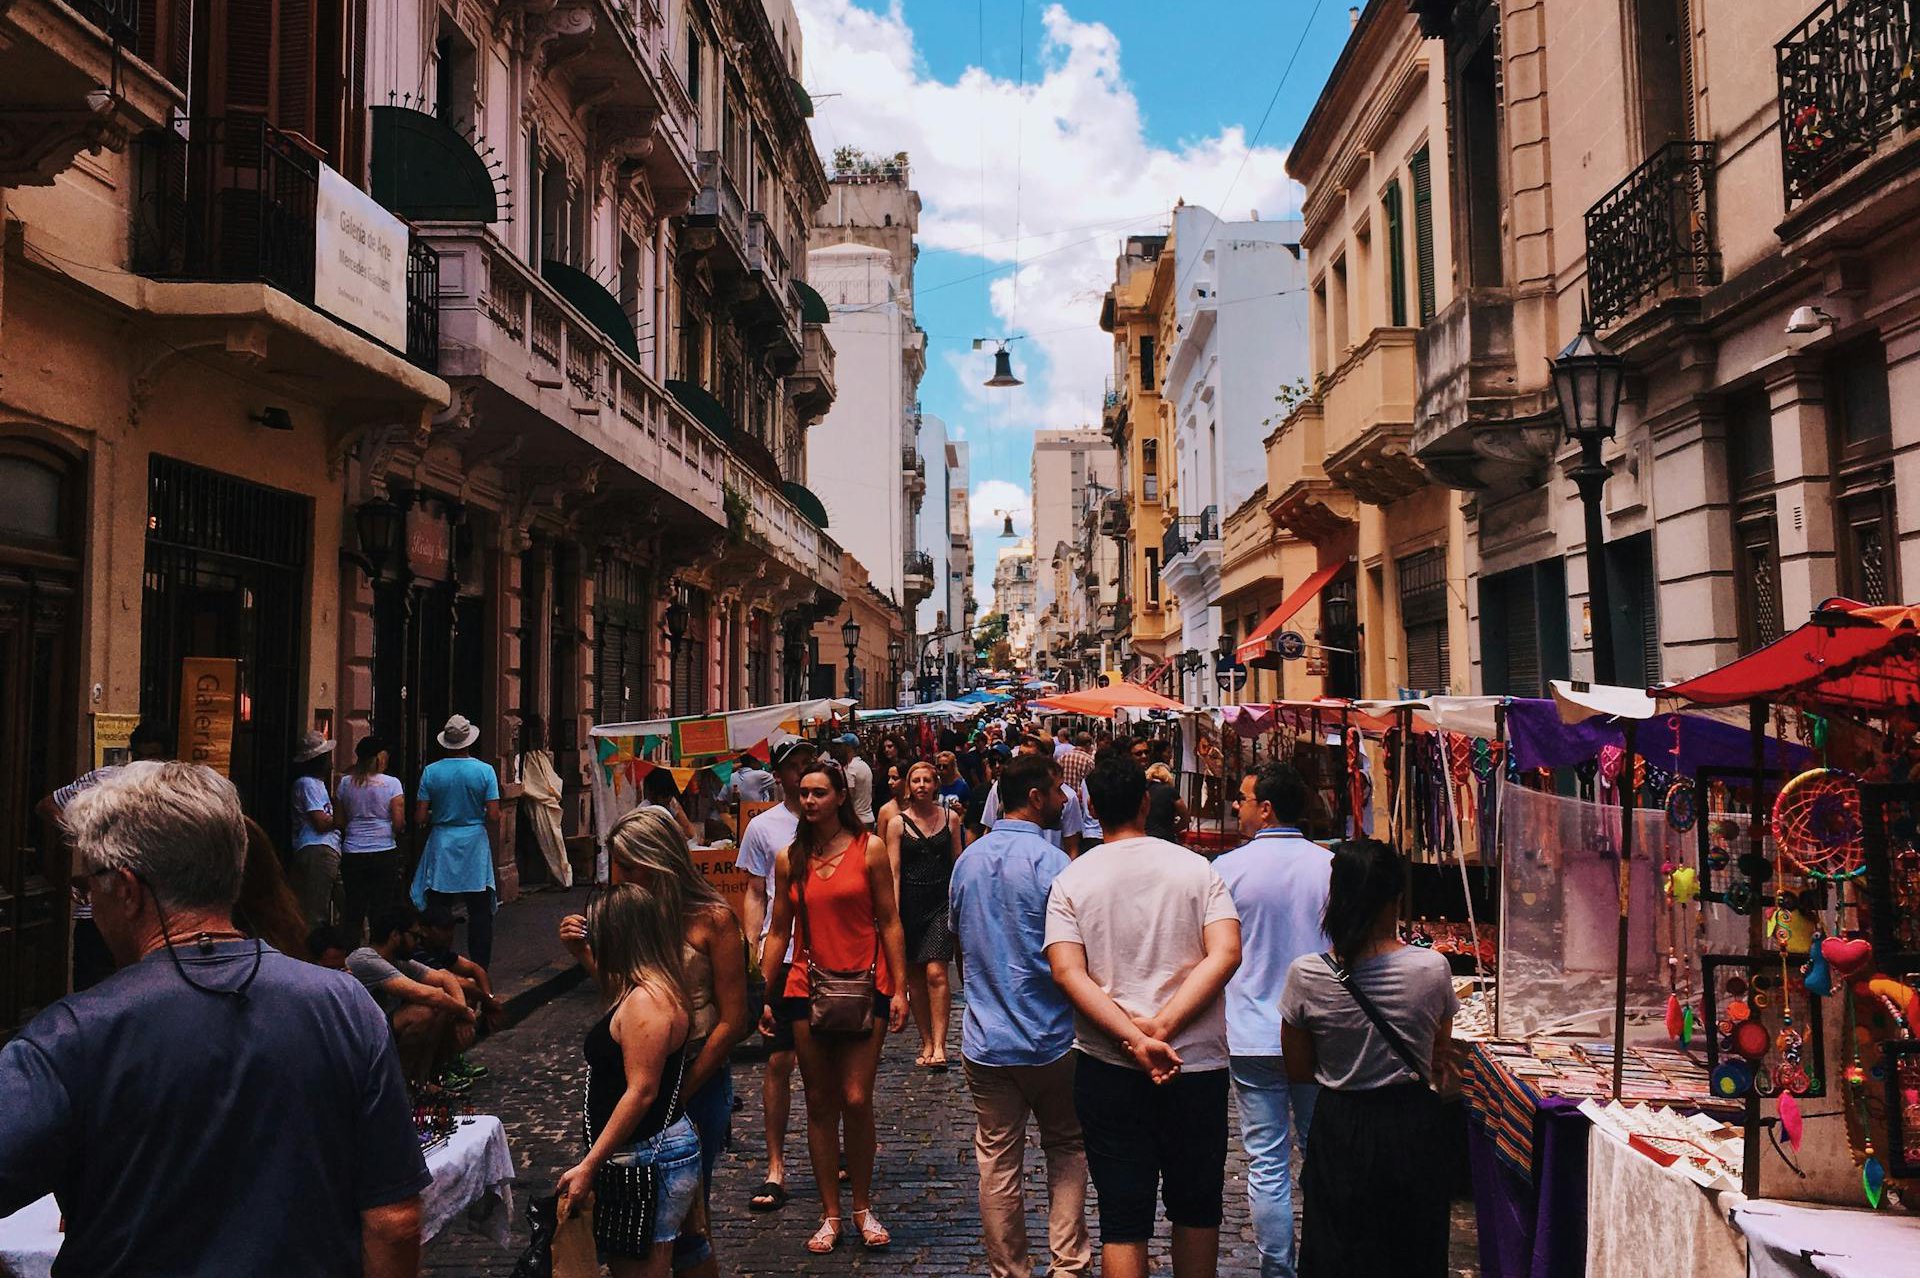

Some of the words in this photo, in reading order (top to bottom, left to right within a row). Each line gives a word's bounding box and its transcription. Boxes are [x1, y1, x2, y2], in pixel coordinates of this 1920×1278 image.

[367, 231, 376, 252] de
[377, 237, 392, 263] Arte
[339, 248, 367, 279] Mercedes
[192, 674, 220, 761] Galería
